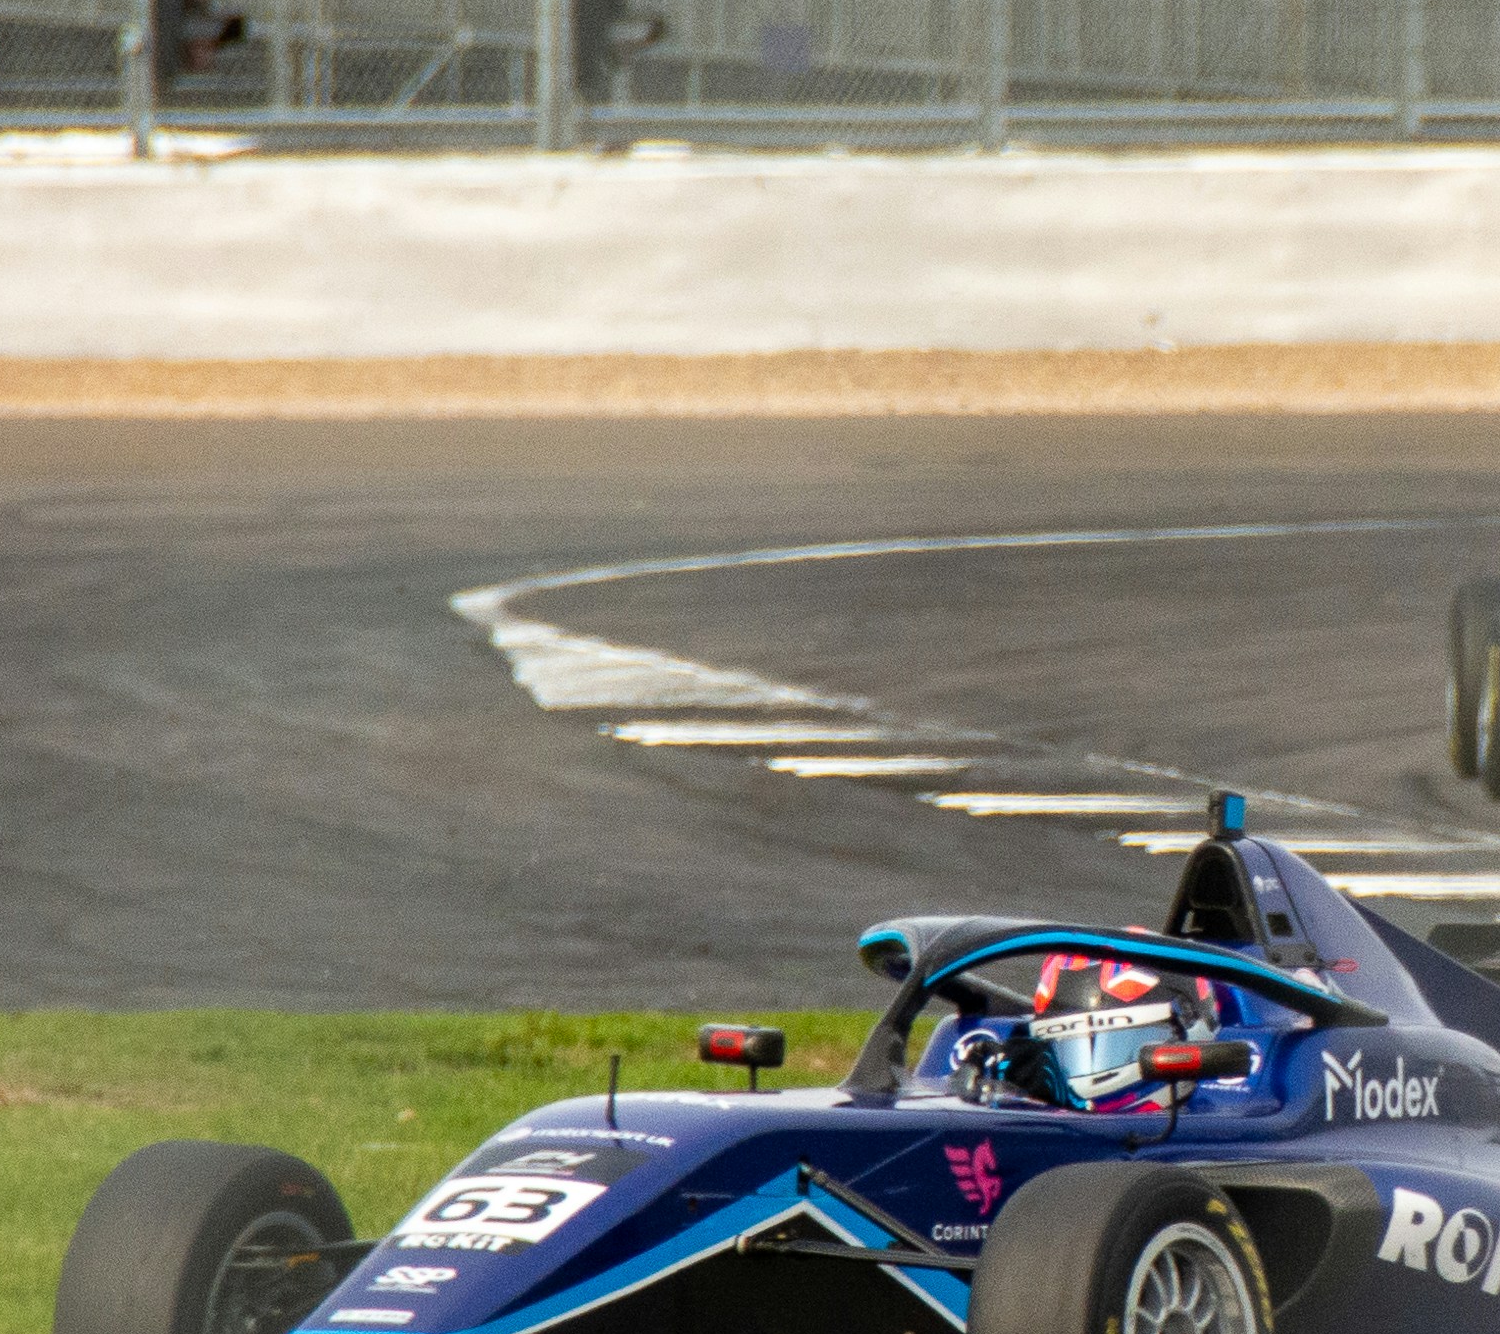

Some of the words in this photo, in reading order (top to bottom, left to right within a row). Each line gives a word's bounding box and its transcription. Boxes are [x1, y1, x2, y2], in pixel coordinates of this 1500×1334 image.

[1035, 1014, 1134, 1035] carlin
[1321, 1049, 1440, 1121] Modex
[423, 1186, 568, 1224] 63
